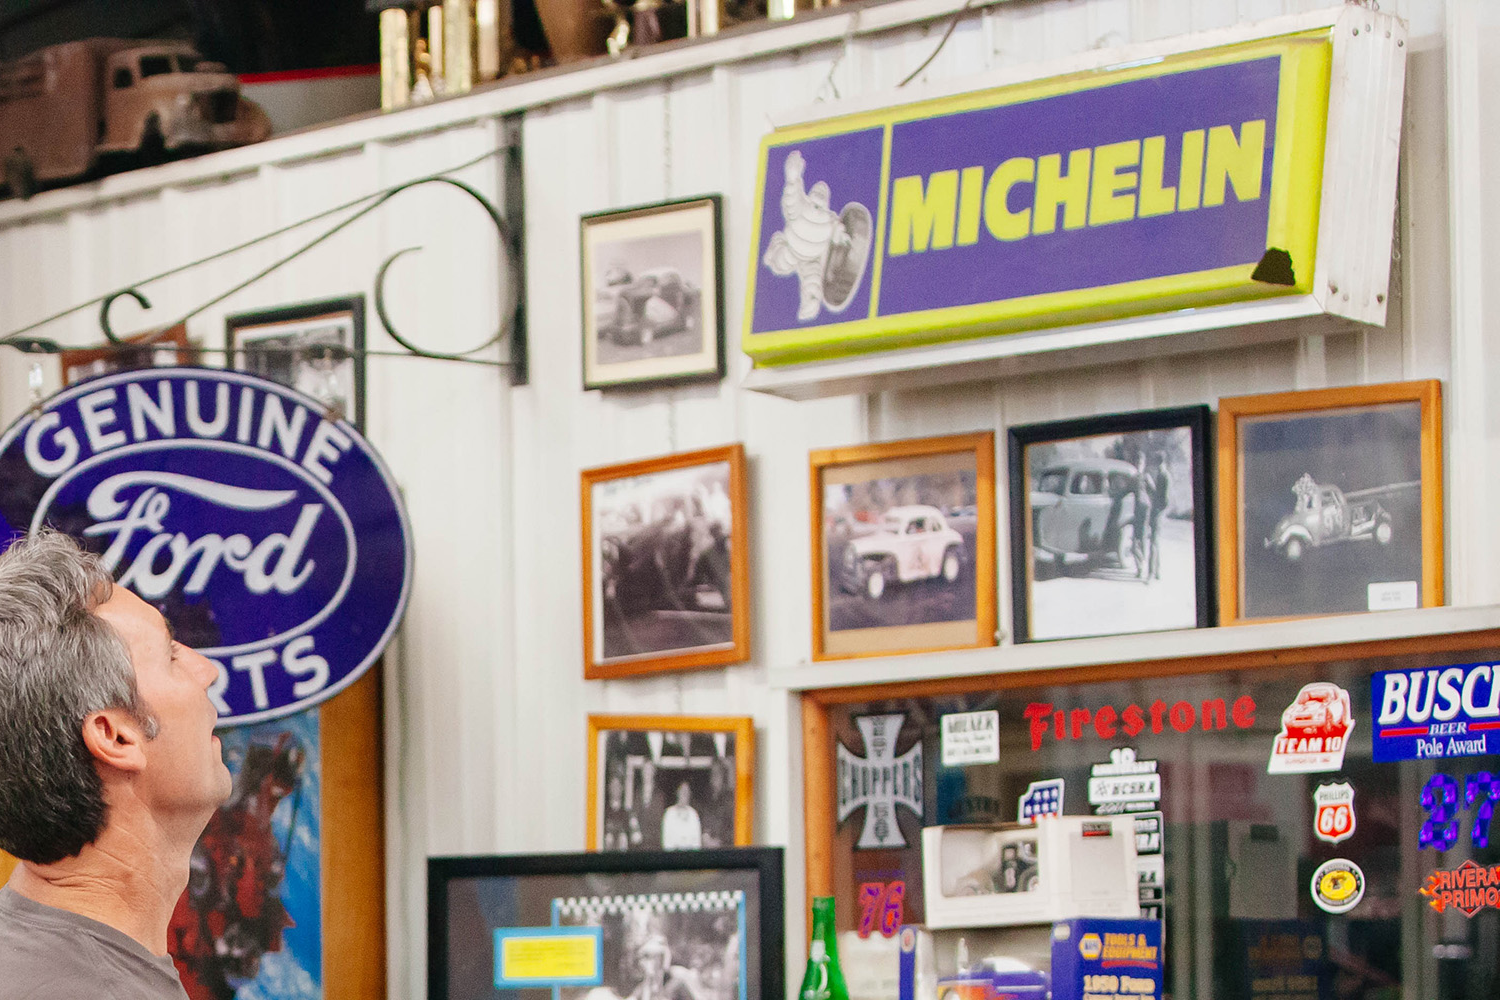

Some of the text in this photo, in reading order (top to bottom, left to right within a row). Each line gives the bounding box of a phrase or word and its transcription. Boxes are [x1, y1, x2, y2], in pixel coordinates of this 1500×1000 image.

[888, 118, 1267, 258] MICHELIN
[23, 378, 354, 486] GENUINE
[82, 469, 326, 600] Ford
[204, 634, 332, 718] RTS
[1023, 694, 1258, 752] Firestone
[1429, 721, 1468, 736] BEER
[1276, 736, 1344, 754] TEAM 10
[1416, 733, 1488, 758] Pole Award
[1319, 806, 1349, 833] 66
[1439, 866, 1500, 890] RIVERA
